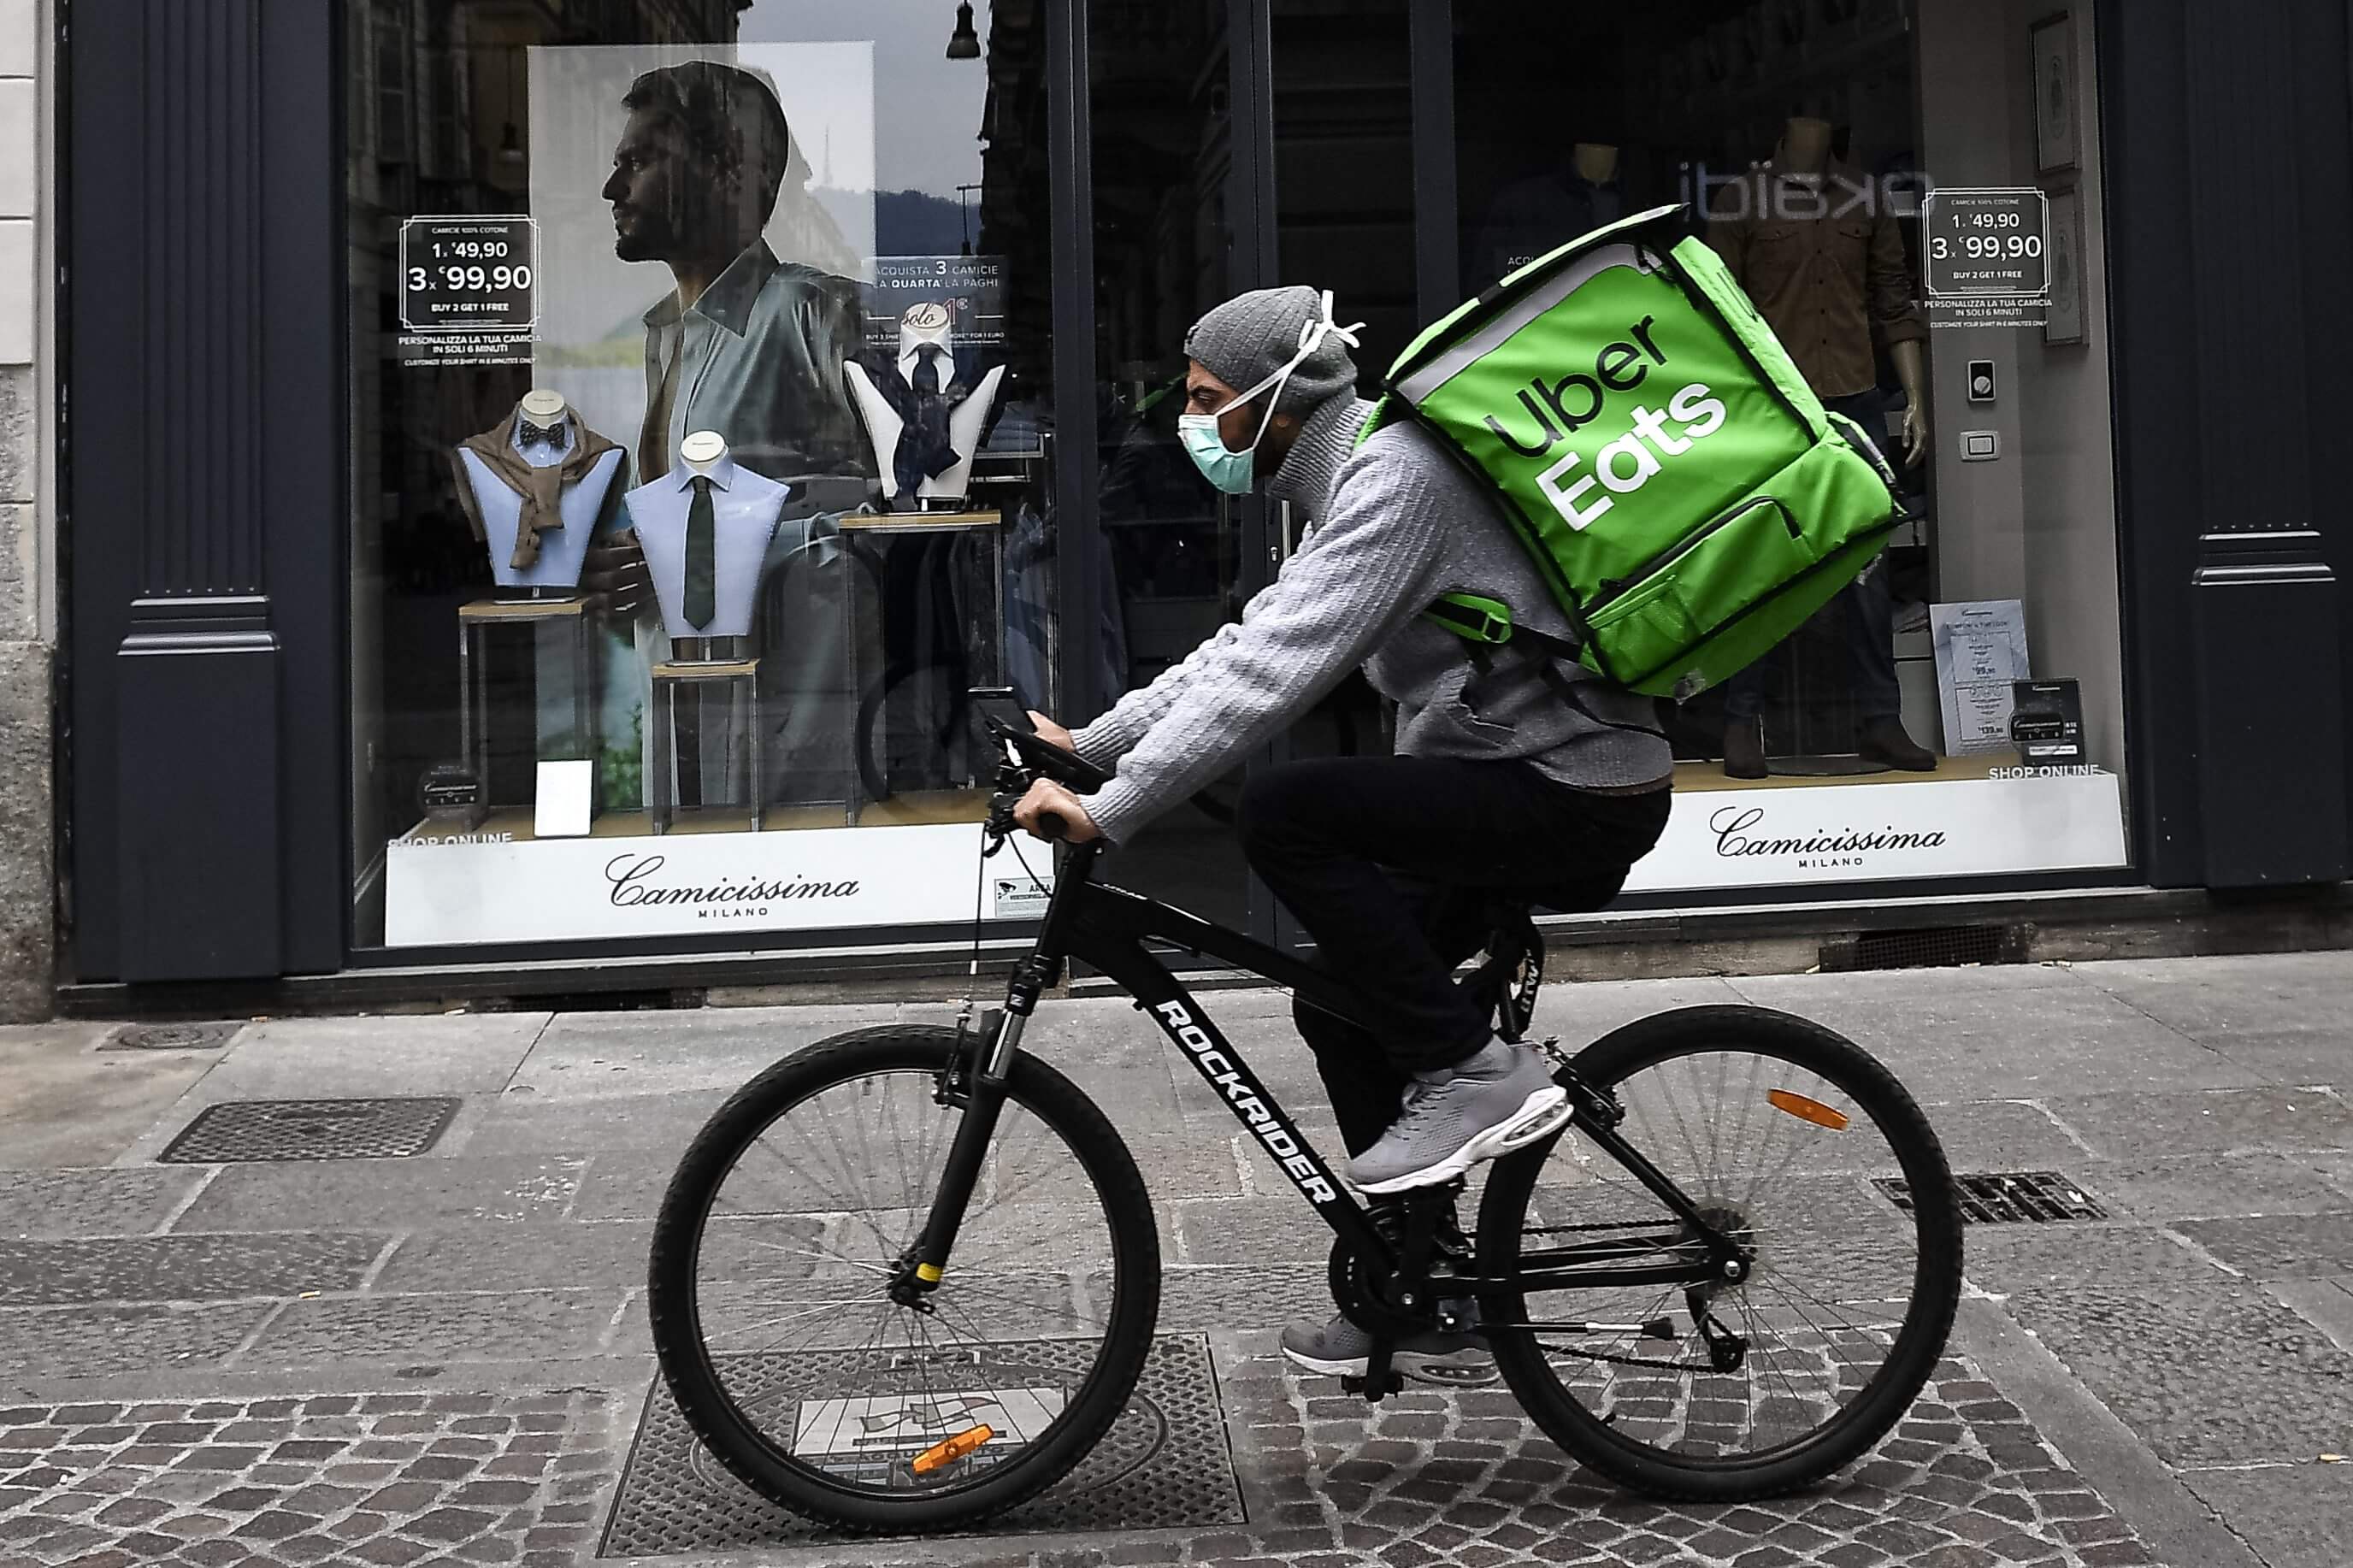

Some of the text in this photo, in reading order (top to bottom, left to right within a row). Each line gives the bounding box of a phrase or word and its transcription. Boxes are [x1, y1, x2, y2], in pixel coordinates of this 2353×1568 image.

[935, 260, 947, 275] 3
[952, 265, 999, 274] CAMICIE
[1953, 271, 1971, 280] BUY
[2002, 270, 2022, 279] FREE
[945, 279, 958, 288] LA
[964, 278, 998, 287] PAGHI
[431, 304, 451, 312] BUY
[460, 303, 479, 311] GET
[481, 303, 486, 311] 1
[487, 303, 510, 311] FREE
[1924, 299, 1985, 309] PERSONALIZZA
[1987, 299, 1997, 308] LA
[2017, 298, 2052, 307] CAMICIA
[902, 302, 935, 326] solo
[398, 333, 541, 345] PERSONALIZZA LA TUA CAMICIA
[445, 345, 466, 353] SOLI
[467, 345, 474, 353] 6
[475, 344, 508, 352] MINUTI
[1483, 315, 1667, 458] Uber
[1535, 383, 1727, 532] Eats
[1989, 763, 2099, 780] SHOP ONLINE
[1710, 805, 1946, 857] Camicissima
[1799, 858, 1864, 869] MILANO
[605, 853, 859, 907] Camicissima
[1029, 883, 1052, 893] ARA
[698, 907, 769, 919] MILANO
[1156, 999, 1336, 1205] ROCKRIDER
